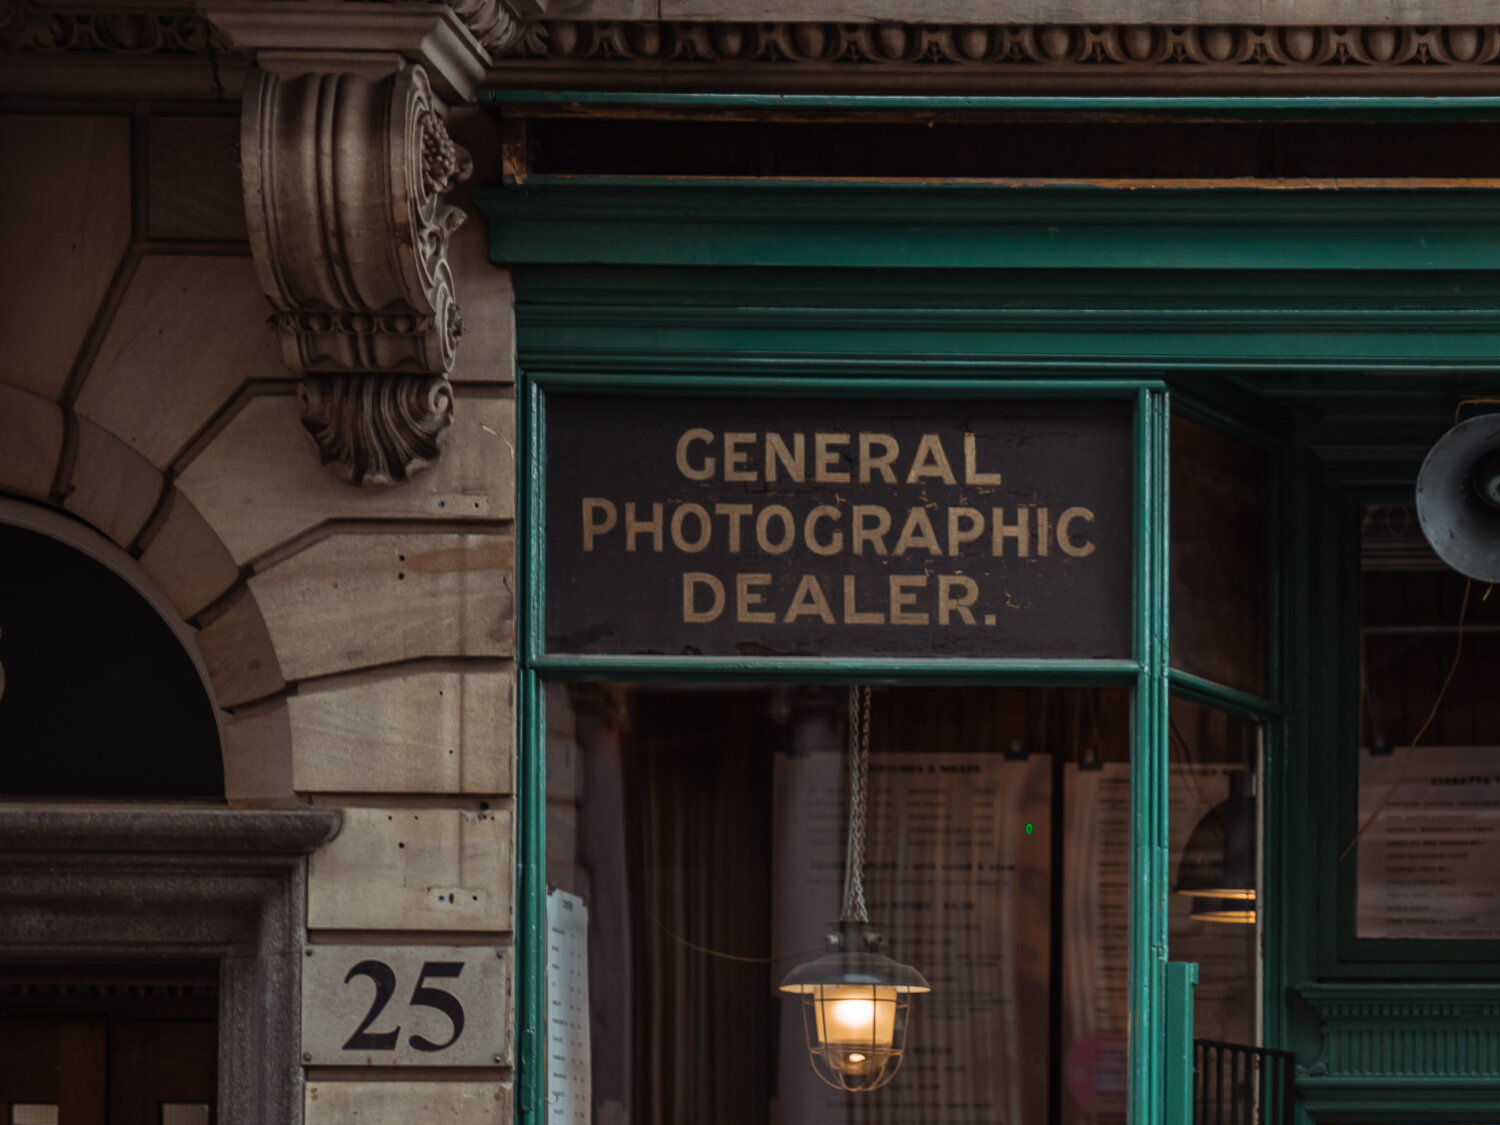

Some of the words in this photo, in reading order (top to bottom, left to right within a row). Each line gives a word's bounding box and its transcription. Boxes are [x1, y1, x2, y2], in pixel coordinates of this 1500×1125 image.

[675, 427, 1002, 486] GENERAL
[581, 497, 1095, 558] PHOTOGRAPHIC
[682, 571, 997, 627] DEALER.
[341, 959, 466, 1052] 25
